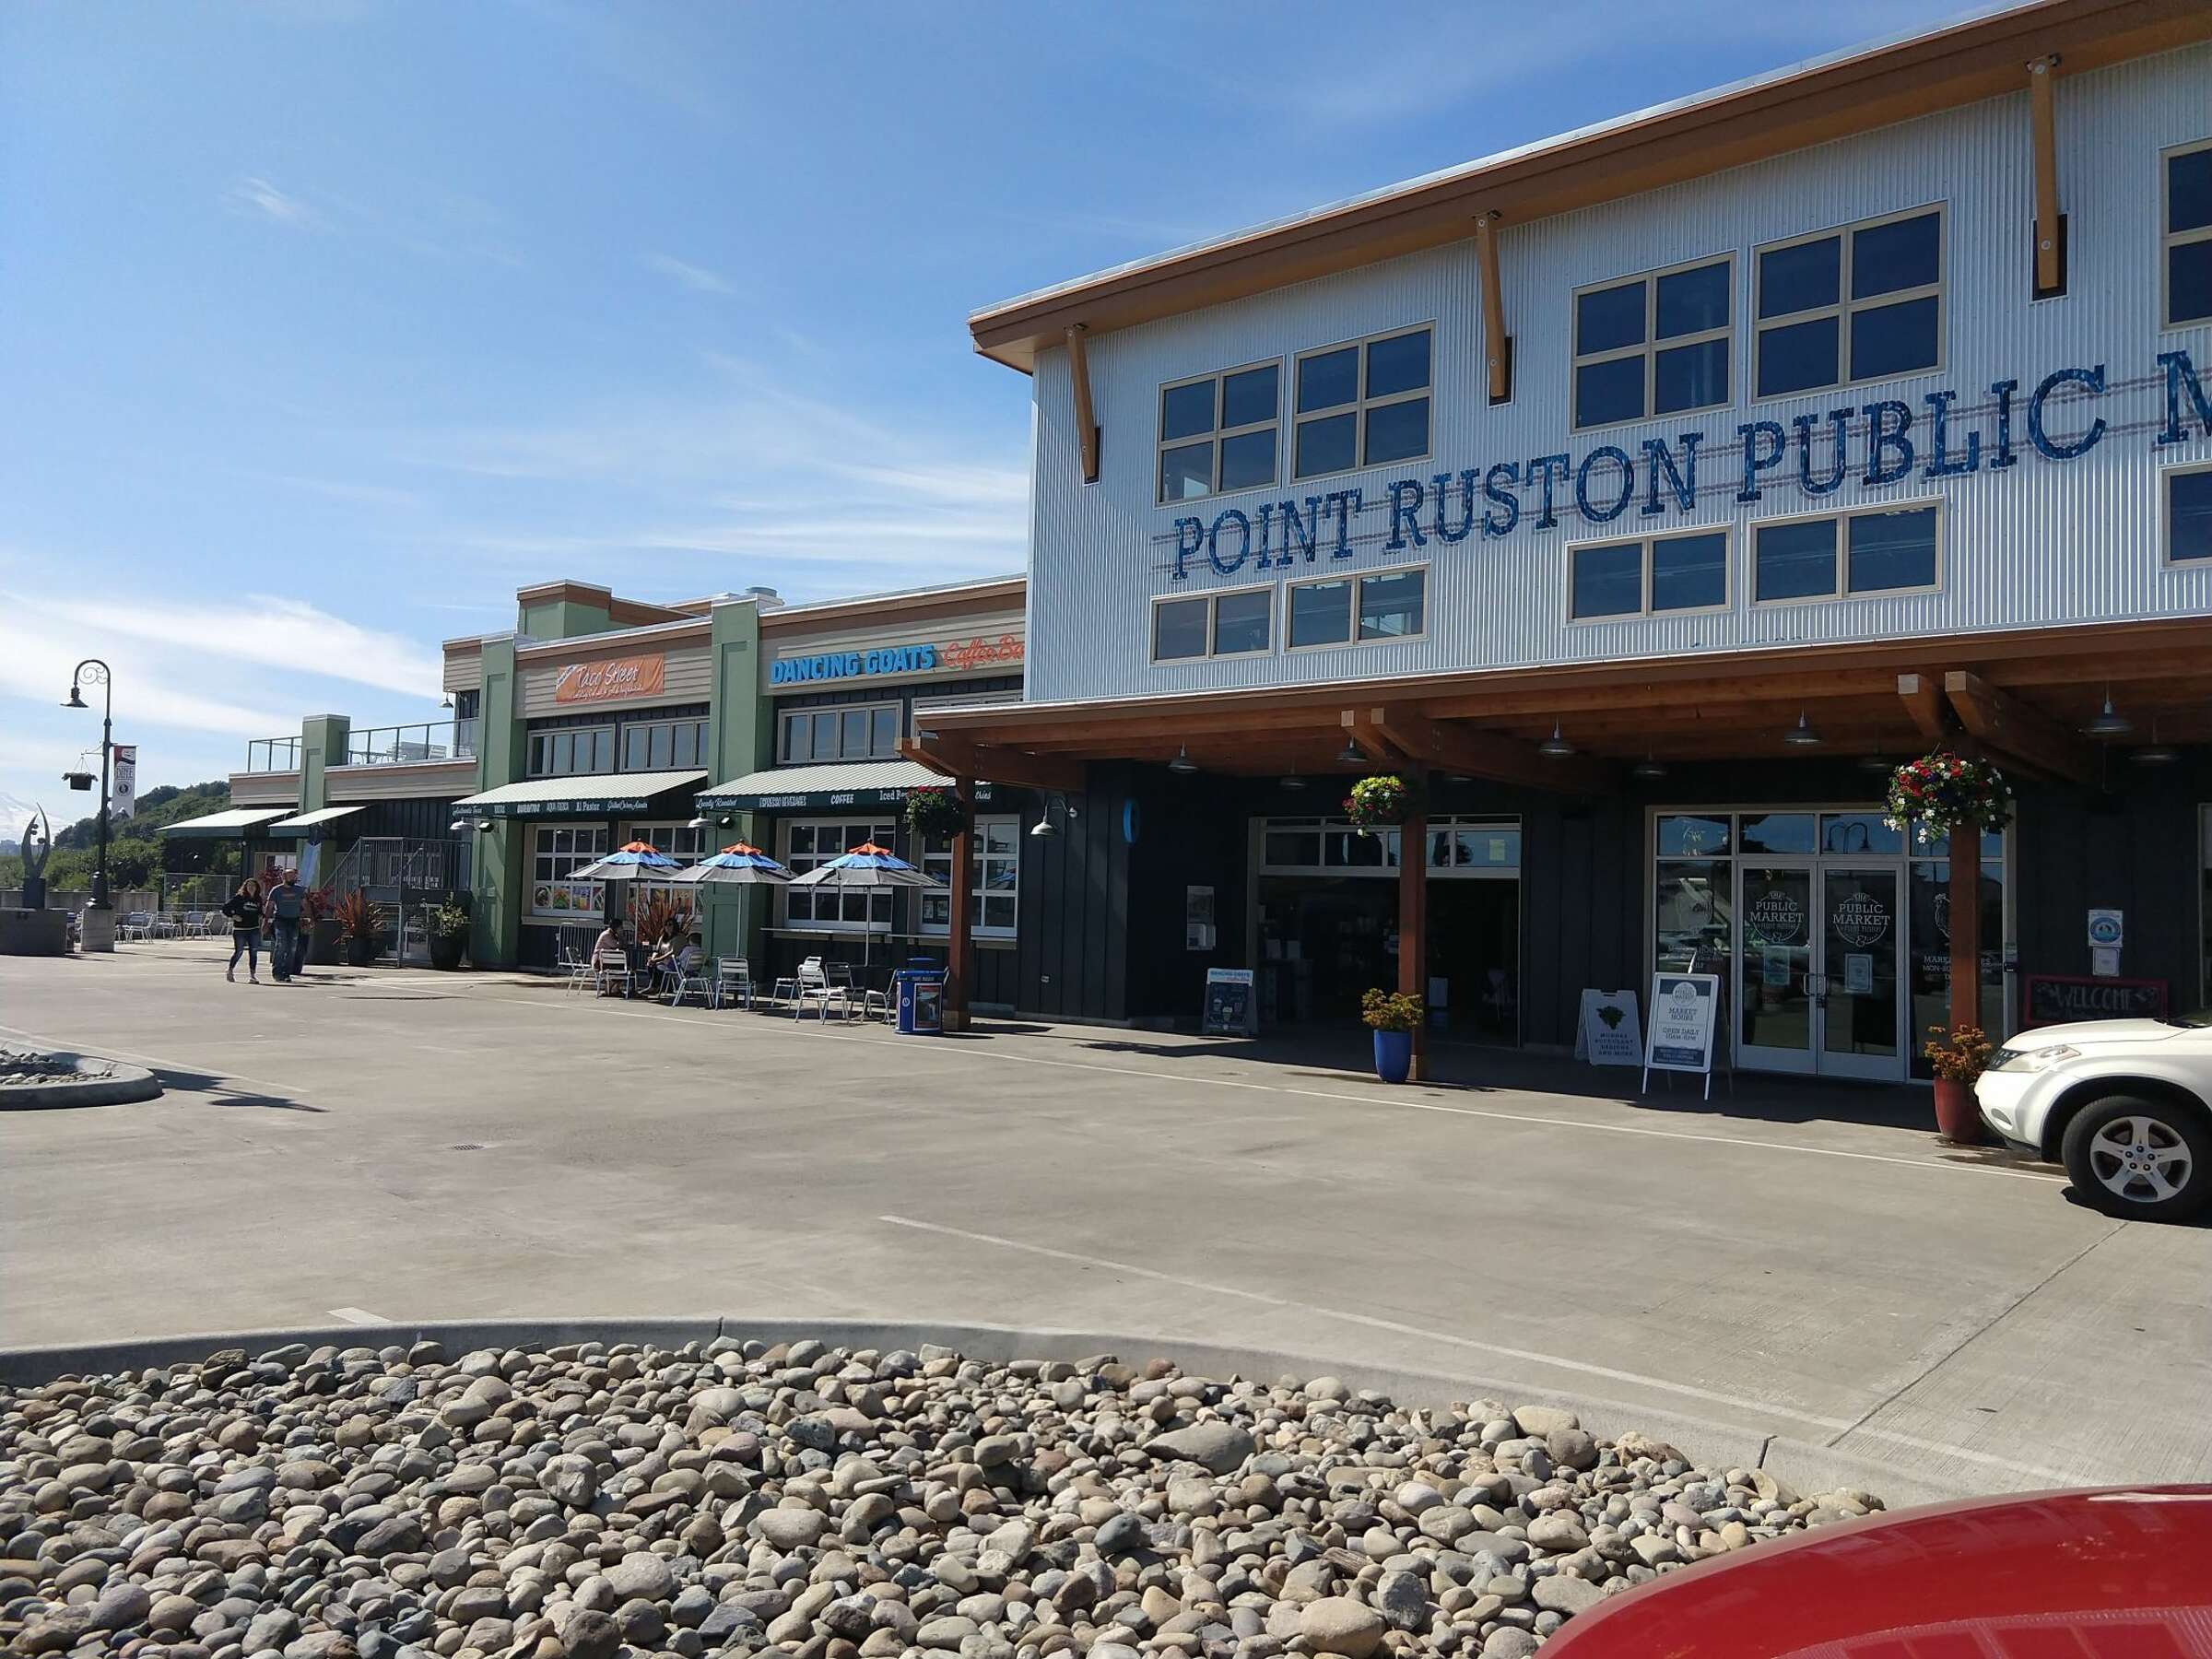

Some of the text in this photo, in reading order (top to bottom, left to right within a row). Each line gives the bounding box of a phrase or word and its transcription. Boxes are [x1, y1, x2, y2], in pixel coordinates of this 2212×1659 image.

[1171, 488, 1362, 581] POINT
[1385, 430, 1704, 550] RUSTON
[1736, 363, 2107, 503] PUBLIC
[770, 634, 1025, 685] DANCING GOATS Coffee Ba
[577, 663, 639, 688] Taco Street
[830, 794, 854, 805] COFFEE
[878, 789, 895, 801] Iced
[1755, 900, 1798, 912] PUBLIC
[1839, 903, 1884, 913] PUBLIC
[1749, 912, 1805, 924] MARKET
[1832, 913, 1891, 926] MARKET
[2054, 983, 2132, 1010] WELCOME
[1668, 1006, 1698, 1015] MARKET
